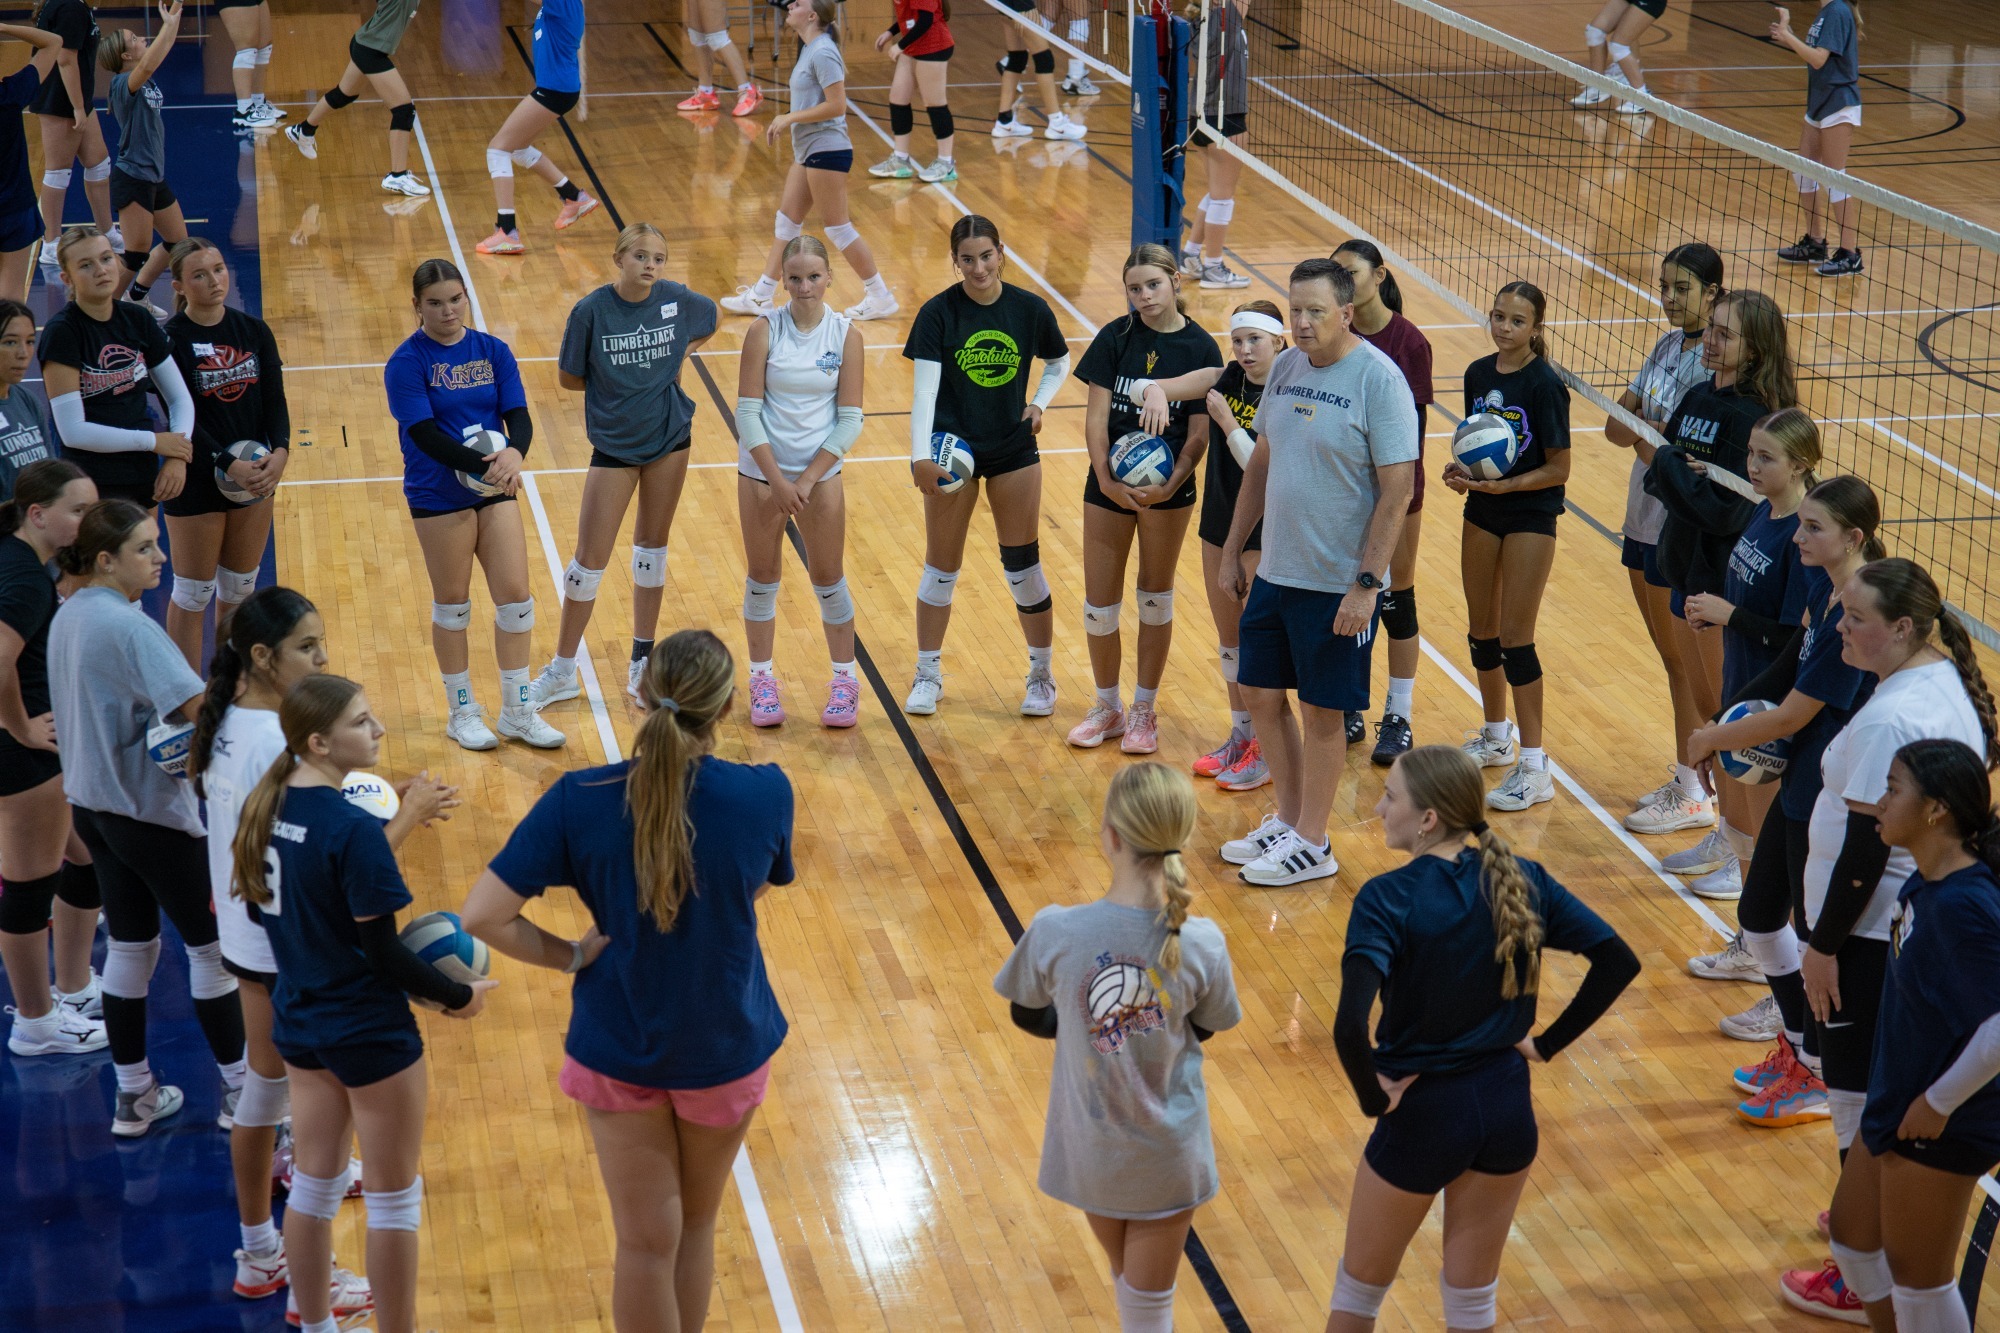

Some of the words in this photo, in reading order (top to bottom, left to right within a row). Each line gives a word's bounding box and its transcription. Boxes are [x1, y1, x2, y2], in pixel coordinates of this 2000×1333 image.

[602, 327, 676, 352] LUMBERJACK
[610, 344, 672, 366] VOLLEYBALL
[954, 346, 1022, 371] Revolution
[201, 358, 256, 386] FEVER
[203, 371, 257, 390] VOLLEYBALL
[1276, 384, 1352, 410] LUMBERJACKS
[1294, 406, 1313, 416] NAU
[1502, 411, 1521, 420] GOLD
[1677, 414, 1720, 444] NAU
[940, 436, 953, 467] molten
[1115, 435, 1147, 461] molten
[1740, 748, 1785, 769] molten
[341, 784, 381, 798] NAU
[1096, 951, 1113, 968] 35
